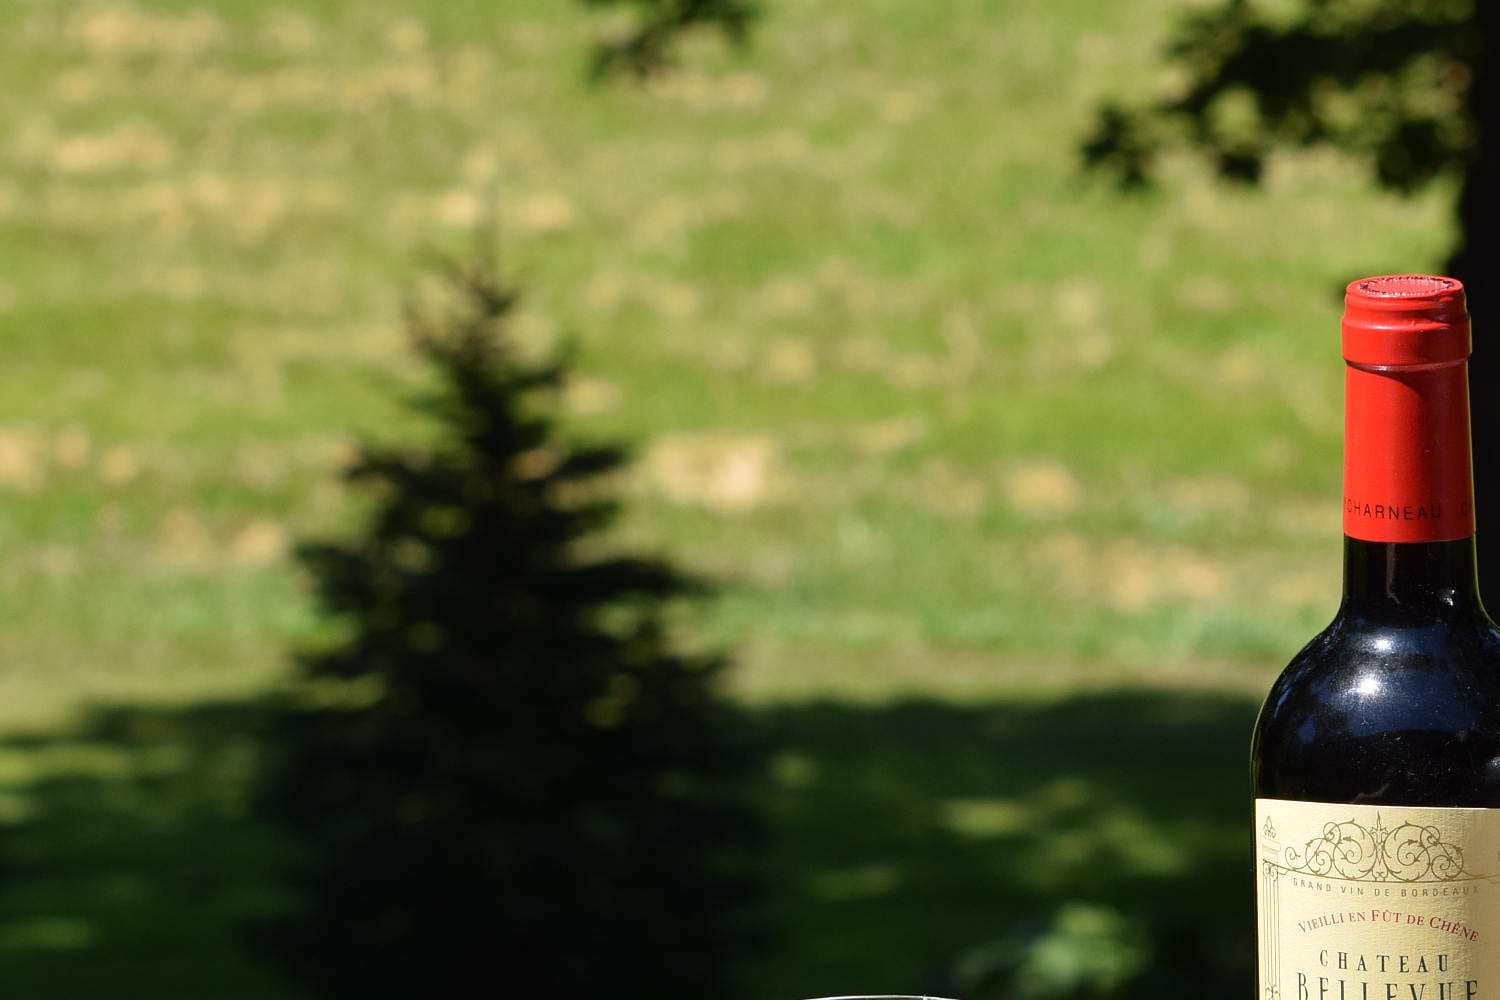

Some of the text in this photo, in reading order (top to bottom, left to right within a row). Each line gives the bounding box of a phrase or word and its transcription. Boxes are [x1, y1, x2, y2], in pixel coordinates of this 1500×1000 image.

[1344, 498, 1441, 520] CHARNEAU
[1293, 877, 1480, 897] GRAND VIN DE BORDEAUX
[1298, 908, 1479, 942] VIEILLI EN FÛT DE CHÊNE
[1319, 950, 1449, 973] CHATEAU
